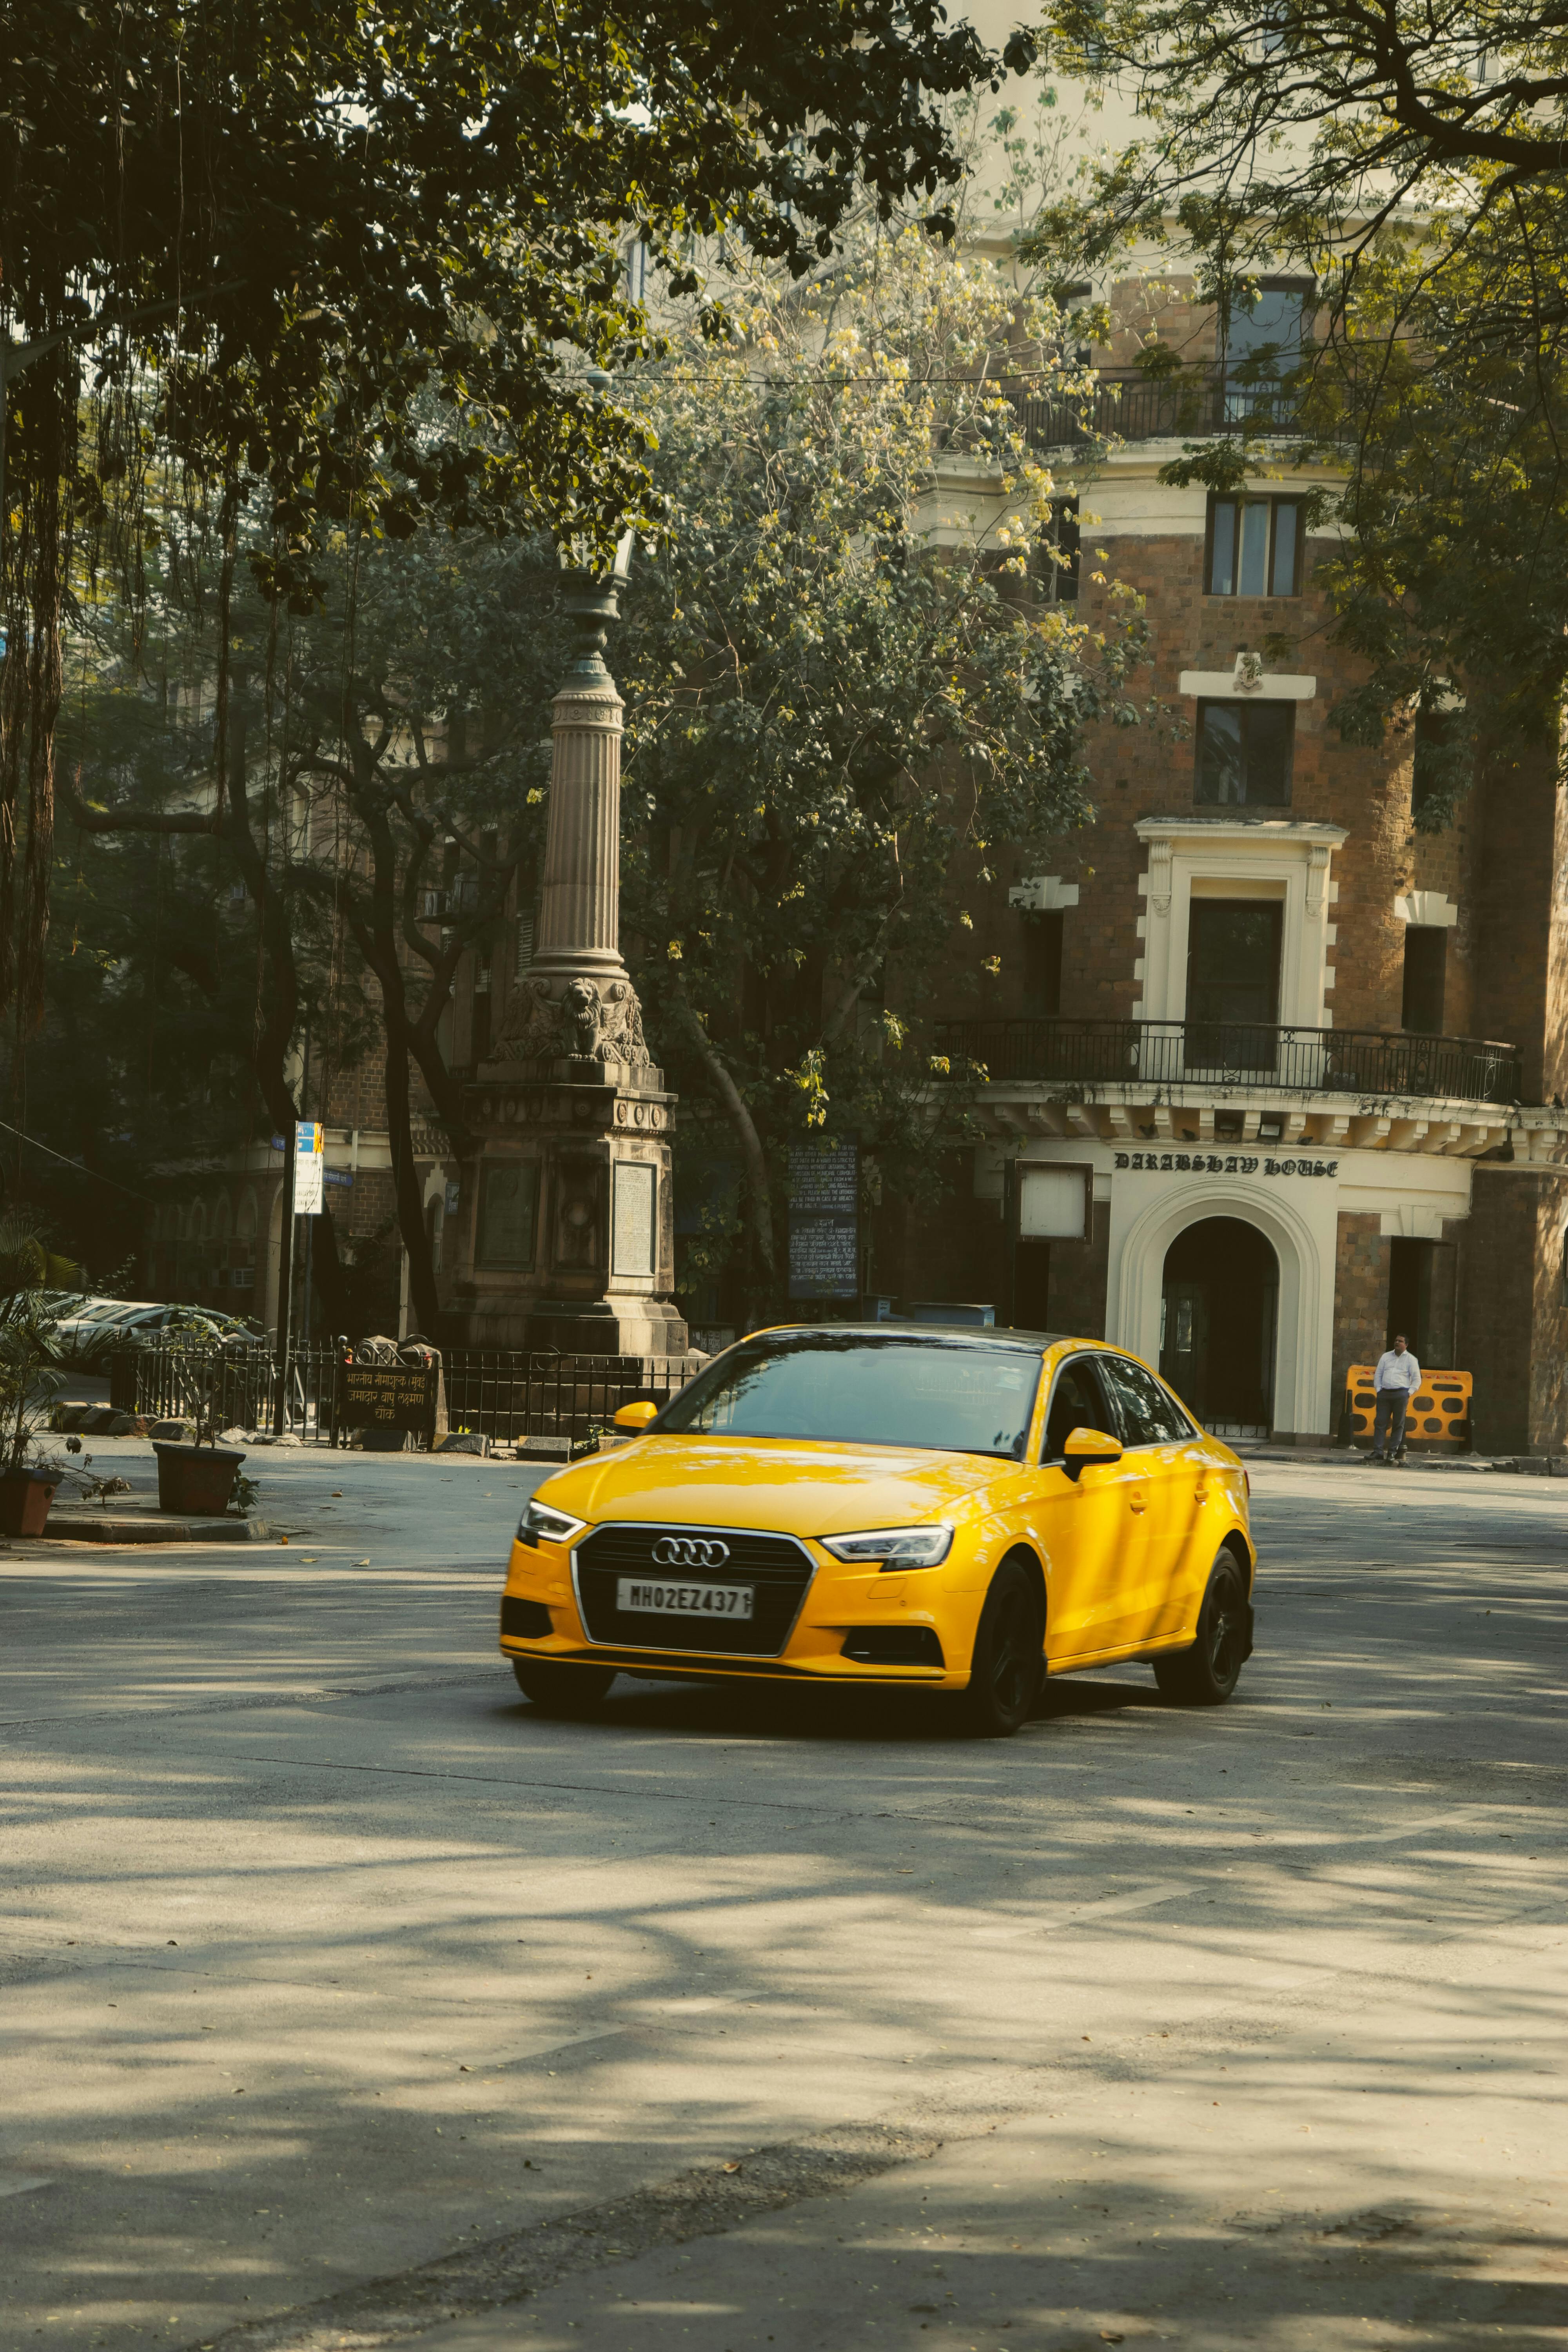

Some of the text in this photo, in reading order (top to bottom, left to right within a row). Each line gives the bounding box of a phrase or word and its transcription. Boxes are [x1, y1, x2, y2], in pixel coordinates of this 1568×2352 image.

[1114, 1152, 1339, 1177] DARABSHAW HOUSE
[347, 1372, 372, 1385] भारतीय
[374, 1372, 406, 1390] सीमाशुल्क
[347, 1390, 378, 1405] जमादार
[397, 1392, 424, 1407] लक्ष्मण
[375, 1405, 395, 1420] चौक
[630, 1584, 751, 1614] MH02EZ4371
